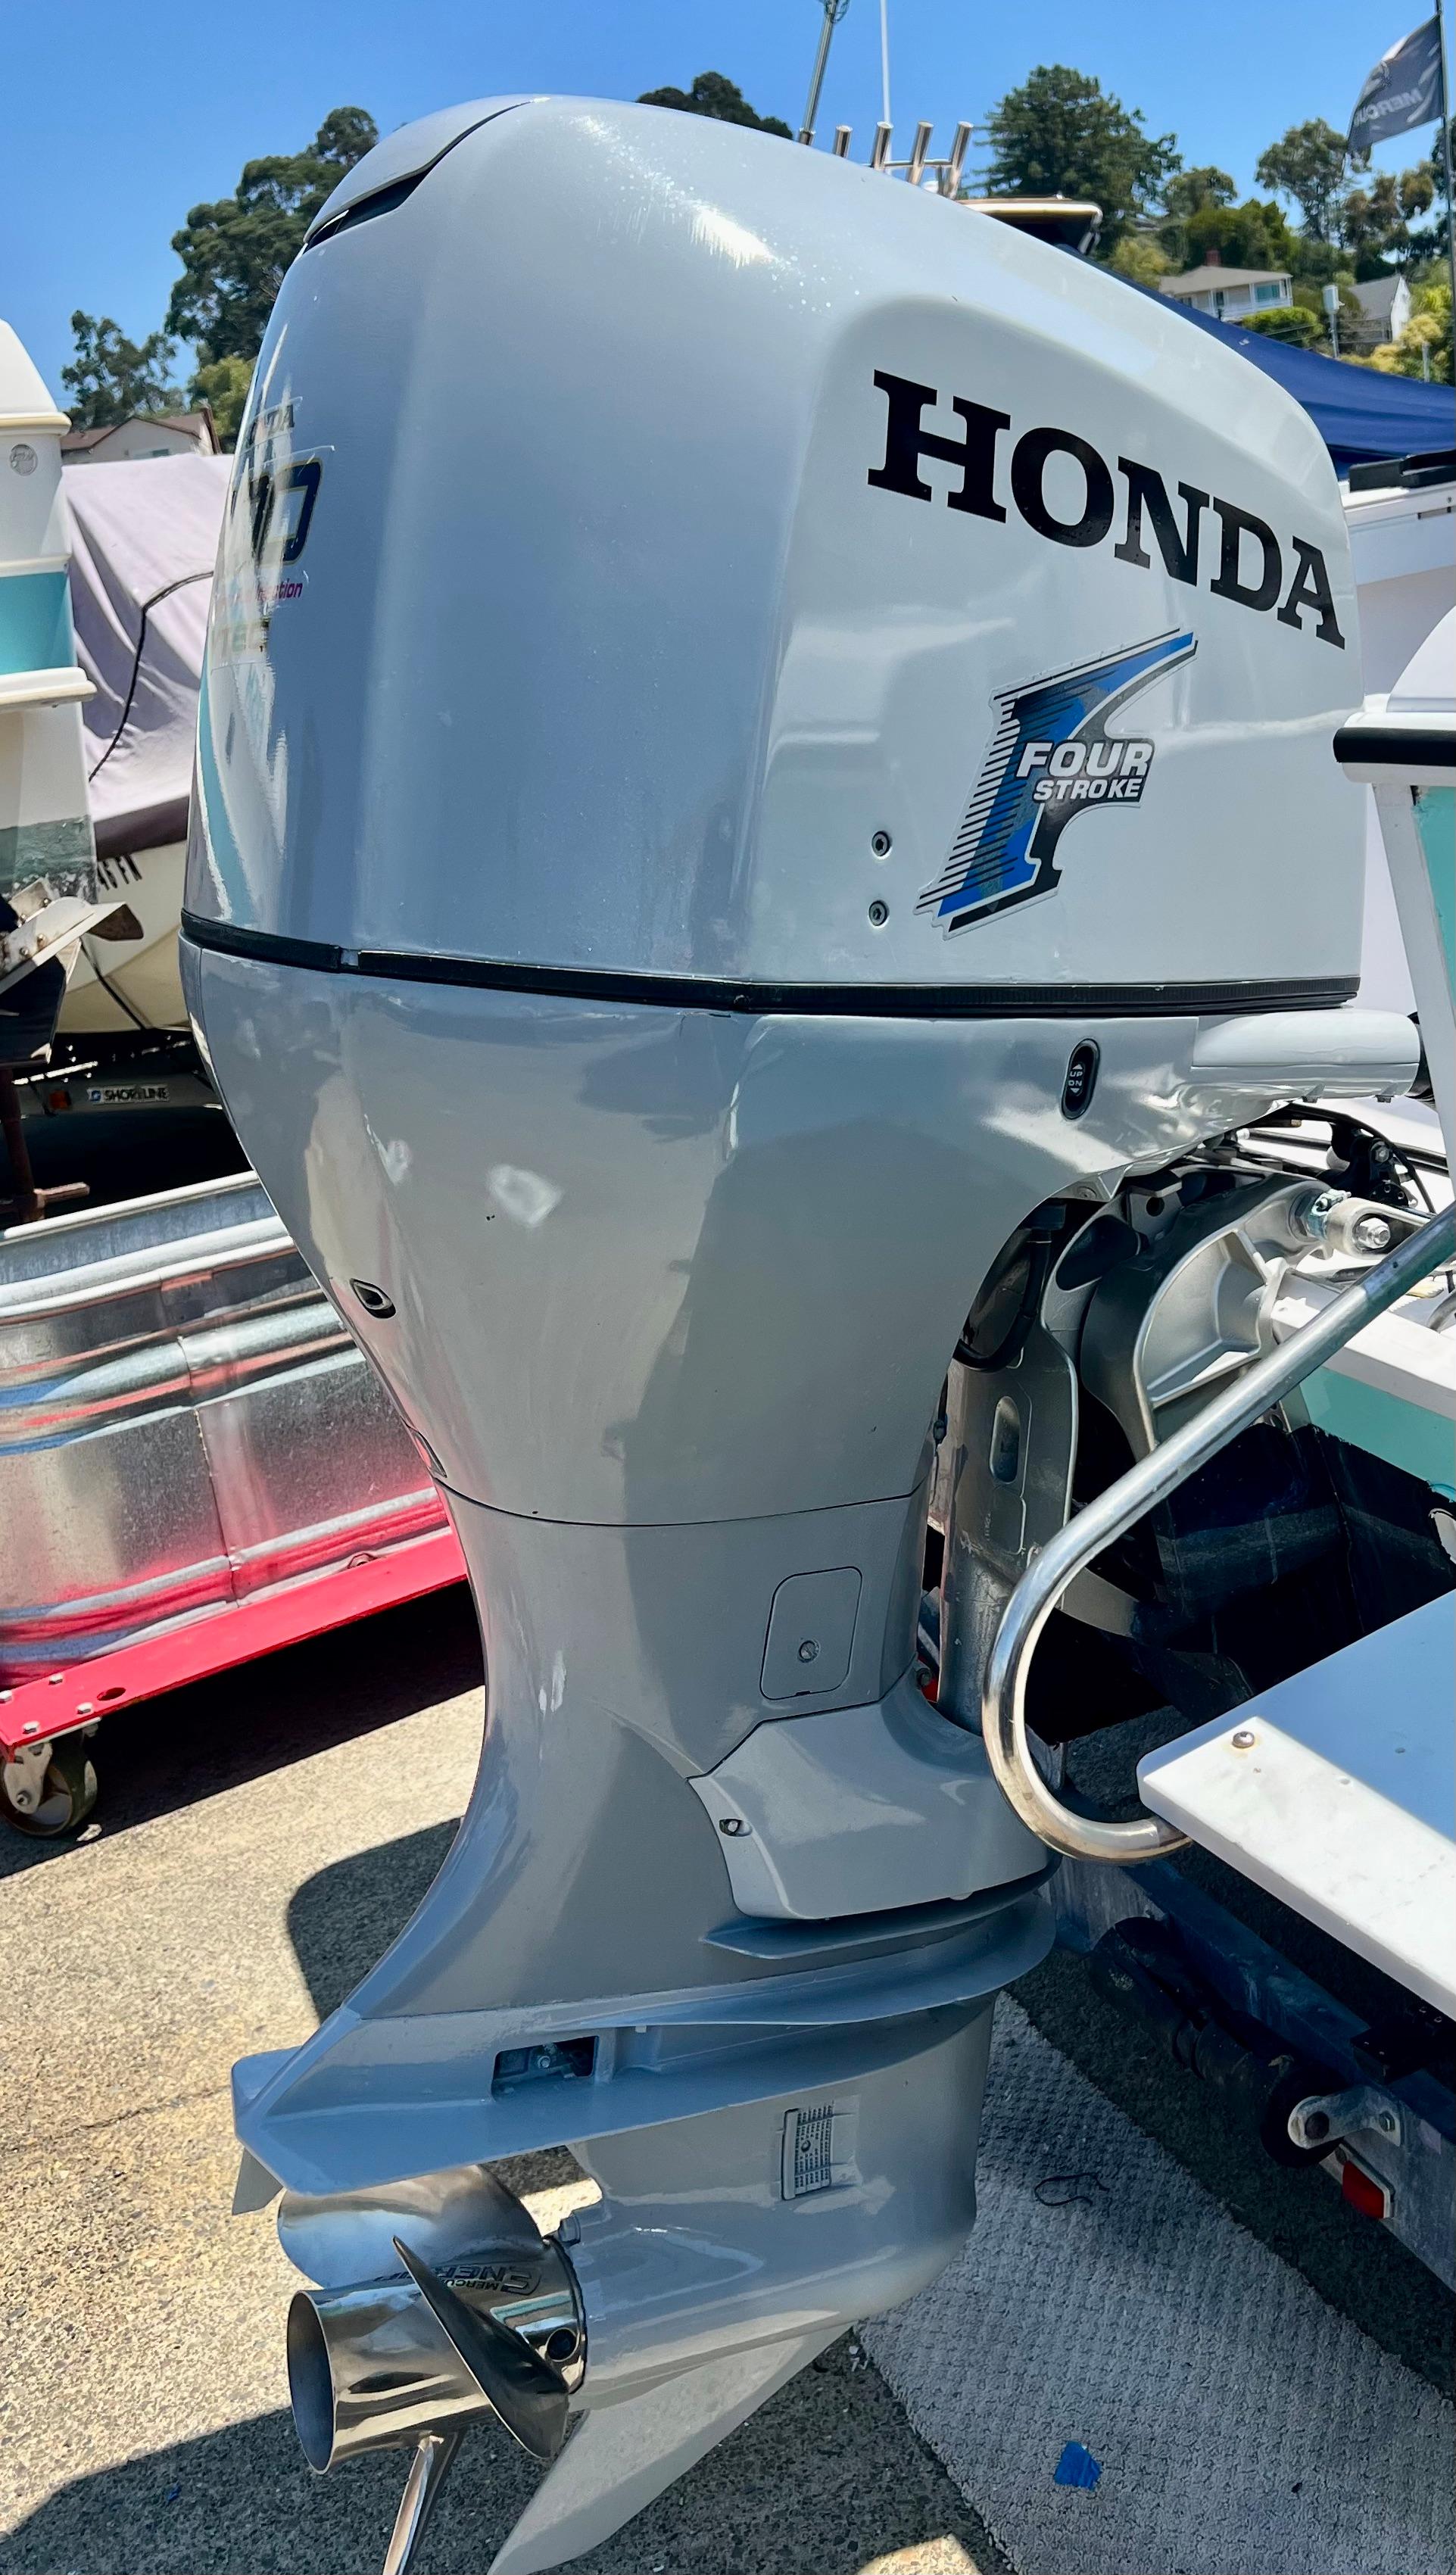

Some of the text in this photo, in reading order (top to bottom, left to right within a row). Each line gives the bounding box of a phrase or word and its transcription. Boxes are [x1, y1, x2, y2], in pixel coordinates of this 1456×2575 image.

[868, 369, 1345, 650] HONDA
[1015, 741, 1153, 778] FOUR
[1033, 778, 1143, 801] STROKE
[444, 2278, 500, 2292] MERCU
